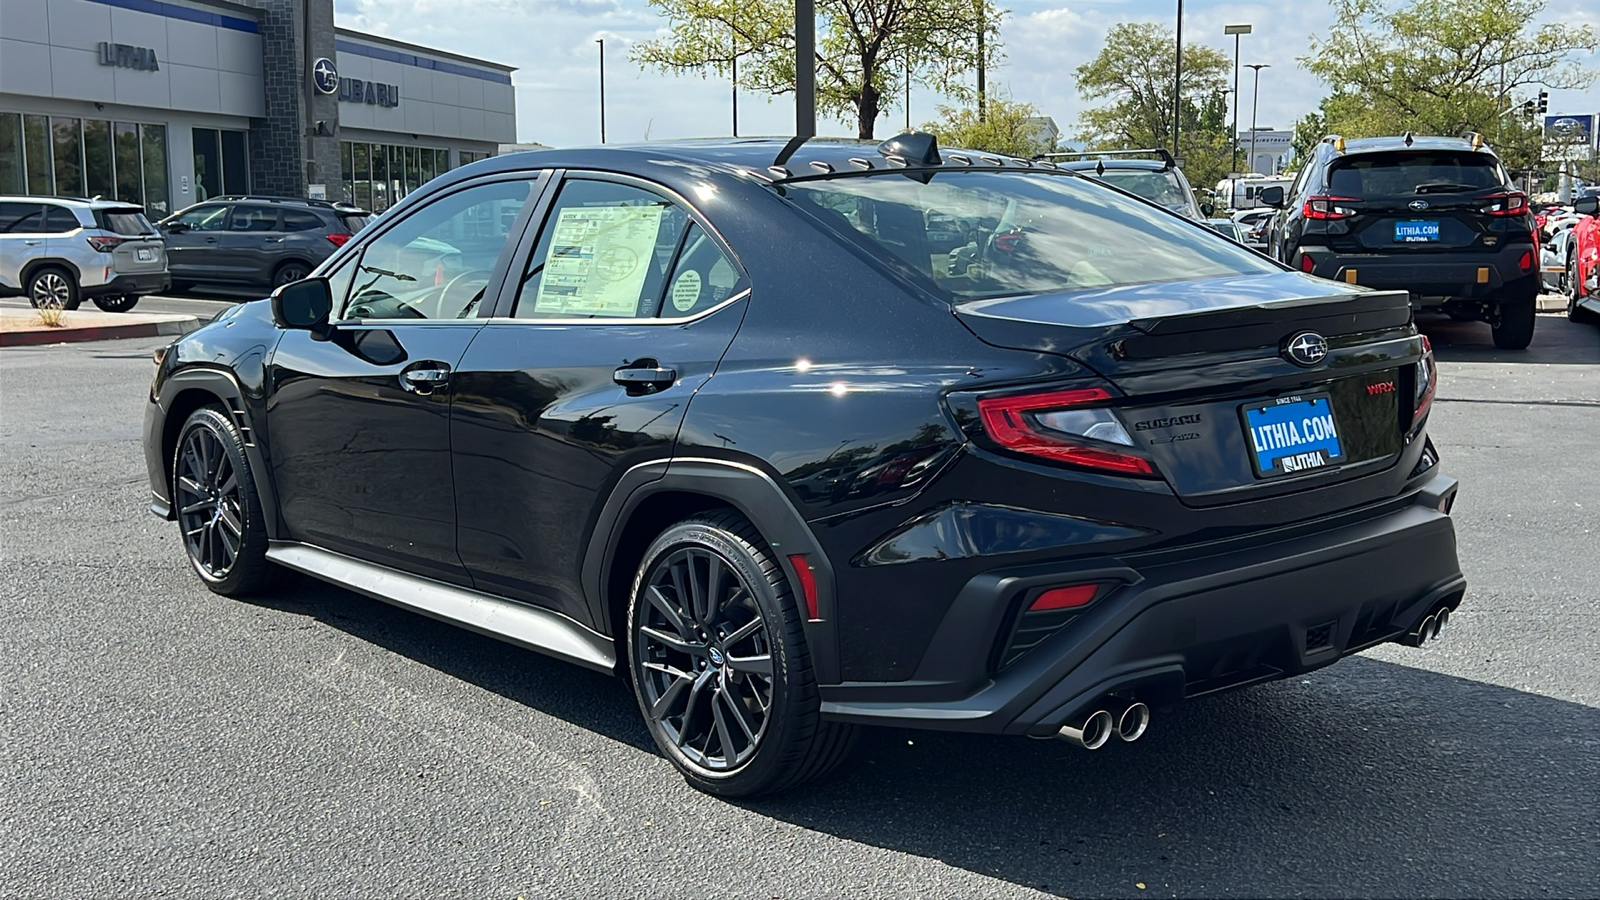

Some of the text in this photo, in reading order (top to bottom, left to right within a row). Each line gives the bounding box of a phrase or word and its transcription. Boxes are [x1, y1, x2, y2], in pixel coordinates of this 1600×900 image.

[98, 41, 160, 72] LITHIA
[338, 76, 399, 108] UBARU
[1395, 225, 1440, 236] LITHIA.COM
[1366, 380, 1396, 396] WRX
[1275, 397, 1291, 406] SINCE
[1134, 413, 1202, 432] SUBARU
[1250, 413, 1337, 453] LITHIA.COM
[1291, 450, 1326, 471] LITHIA
